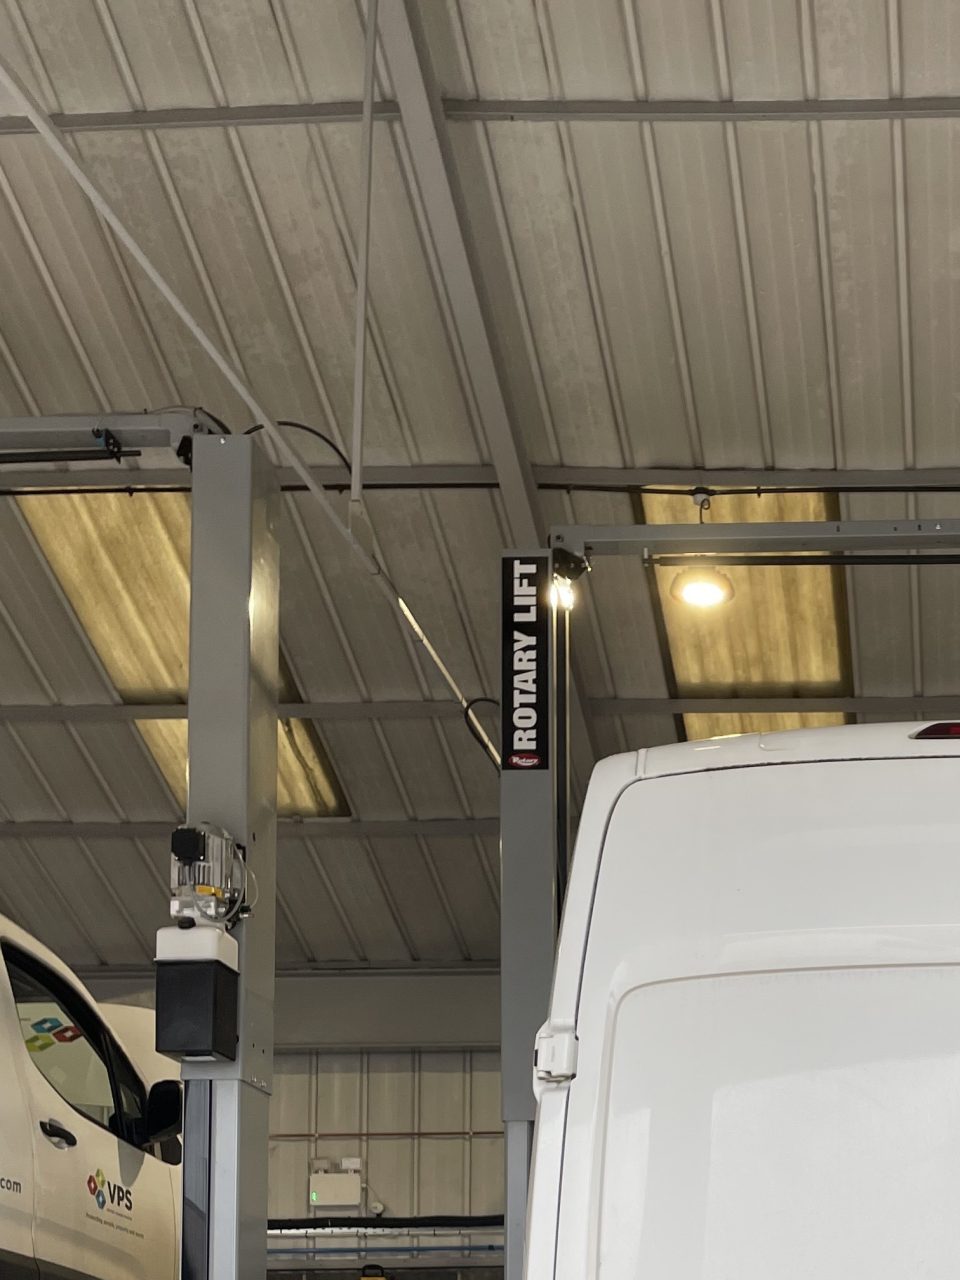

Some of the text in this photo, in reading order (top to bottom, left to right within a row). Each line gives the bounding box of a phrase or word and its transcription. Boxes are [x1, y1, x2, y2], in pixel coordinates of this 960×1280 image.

[513, 560, 537, 750] ROTARY LIFT
[107, 1181, 133, 1211] VPS
